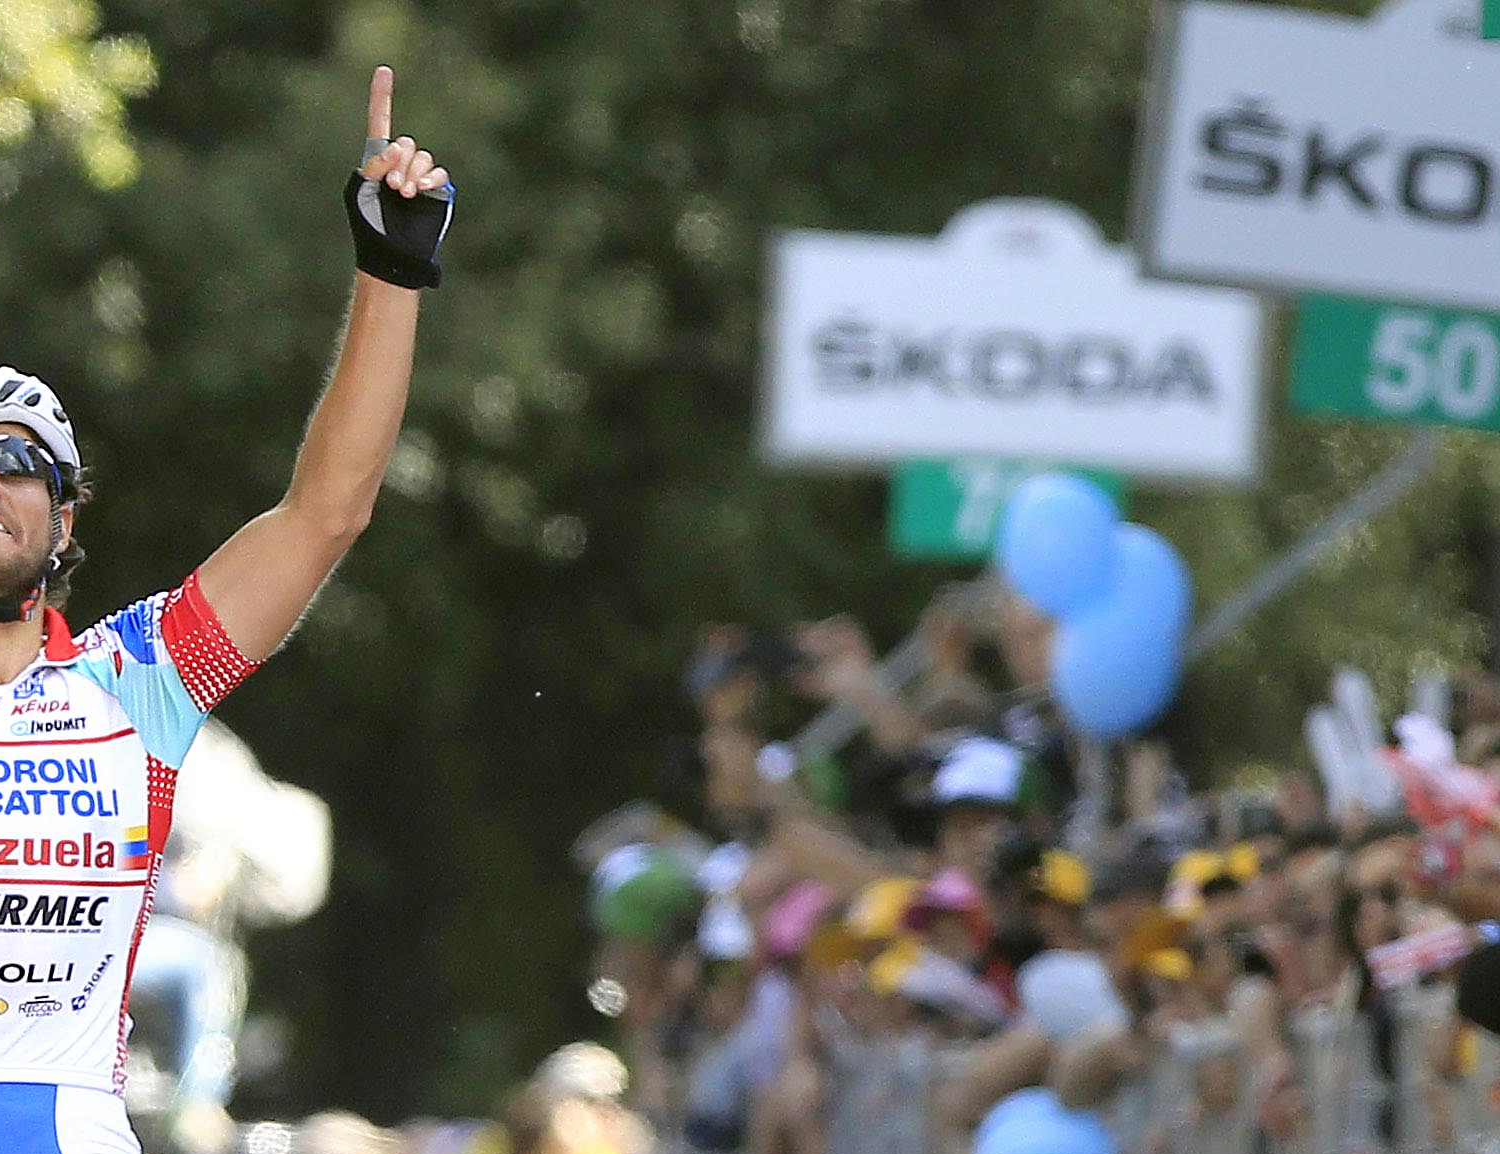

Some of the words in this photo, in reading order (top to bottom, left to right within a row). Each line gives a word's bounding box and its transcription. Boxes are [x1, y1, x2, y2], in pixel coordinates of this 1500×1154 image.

[1200, 97, 1492, 228] ŠKO
[812, 308, 1218, 408] ŠKODA
[1366, 315, 1498, 420] 50
[11, 699, 70, 716] KENDA
[83, 953, 115, 994] SIGMA
